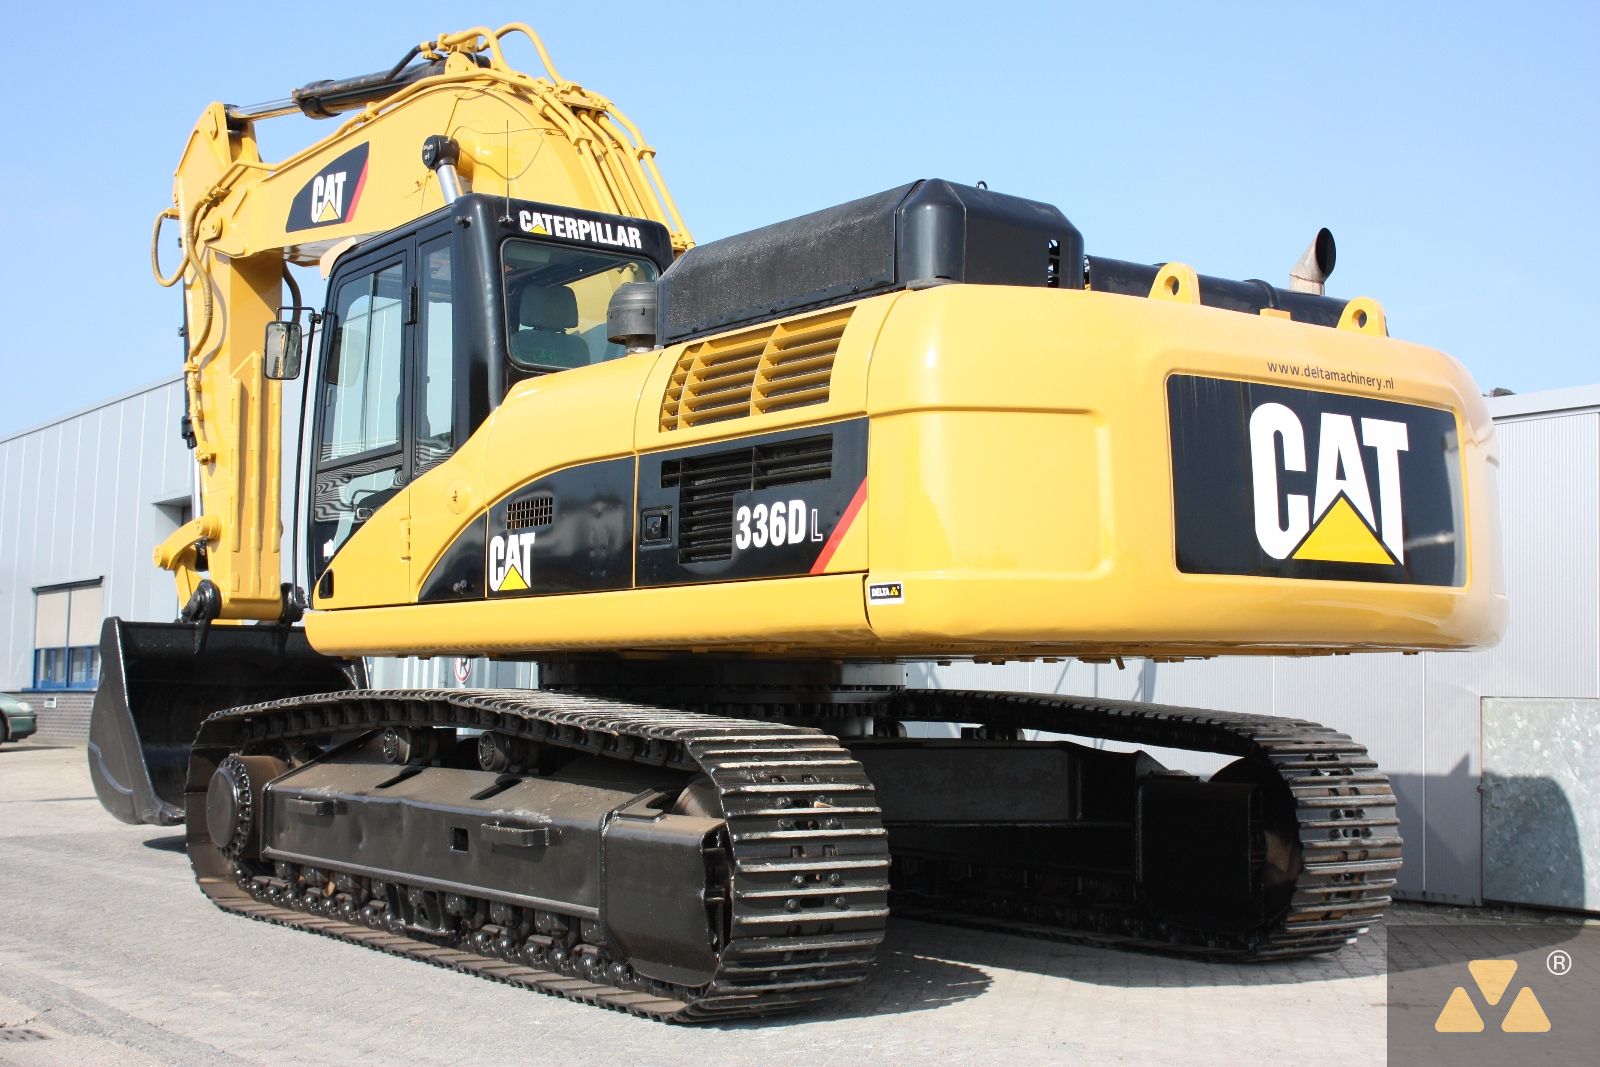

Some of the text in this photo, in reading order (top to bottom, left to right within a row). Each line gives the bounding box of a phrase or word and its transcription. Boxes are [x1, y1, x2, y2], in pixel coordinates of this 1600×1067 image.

[311, 171, 347, 223] CAT
[519, 210, 642, 249] CATERPILLAR
[1267, 362, 1394, 390] www.deltamachinery.nl
[1250, 402, 1409, 566] CAT
[735, 499, 823, 550] 336D L
[489, 532, 536, 592] CAT
[871, 587, 891, 597] DELTA
